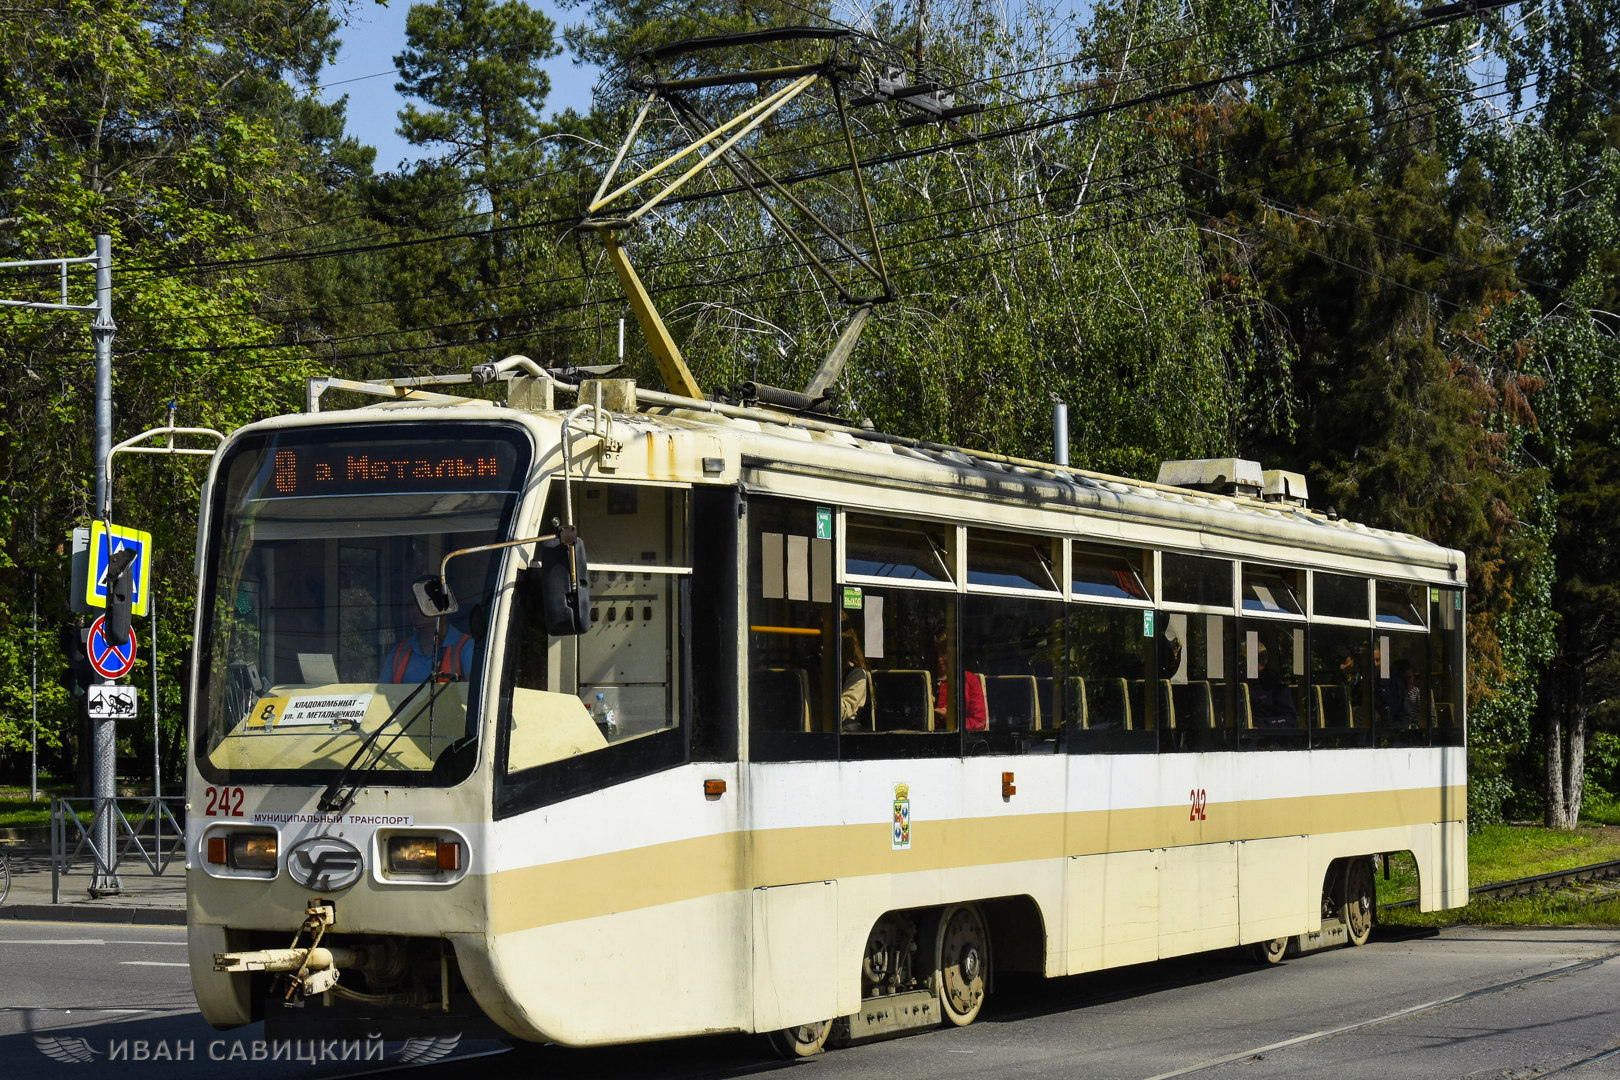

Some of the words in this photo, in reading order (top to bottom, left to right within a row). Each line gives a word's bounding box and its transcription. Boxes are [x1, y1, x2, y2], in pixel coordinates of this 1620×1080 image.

[275, 451, 296, 492] 8
[260, 704, 275, 720] 8
[293, 699, 357, 709] ХЛАДОКОМБИНАТ
[296, 711, 304, 719] П.
[306, 710, 365, 719] МЕТАЛЬИКОВА
[205, 787, 245, 817] 242
[1190, 789, 1206, 821] 242
[254, 813, 343, 824] МУНИЦИПАЛЬНЫЙ
[349, 815, 410, 825] ТРАНСПОРТ
